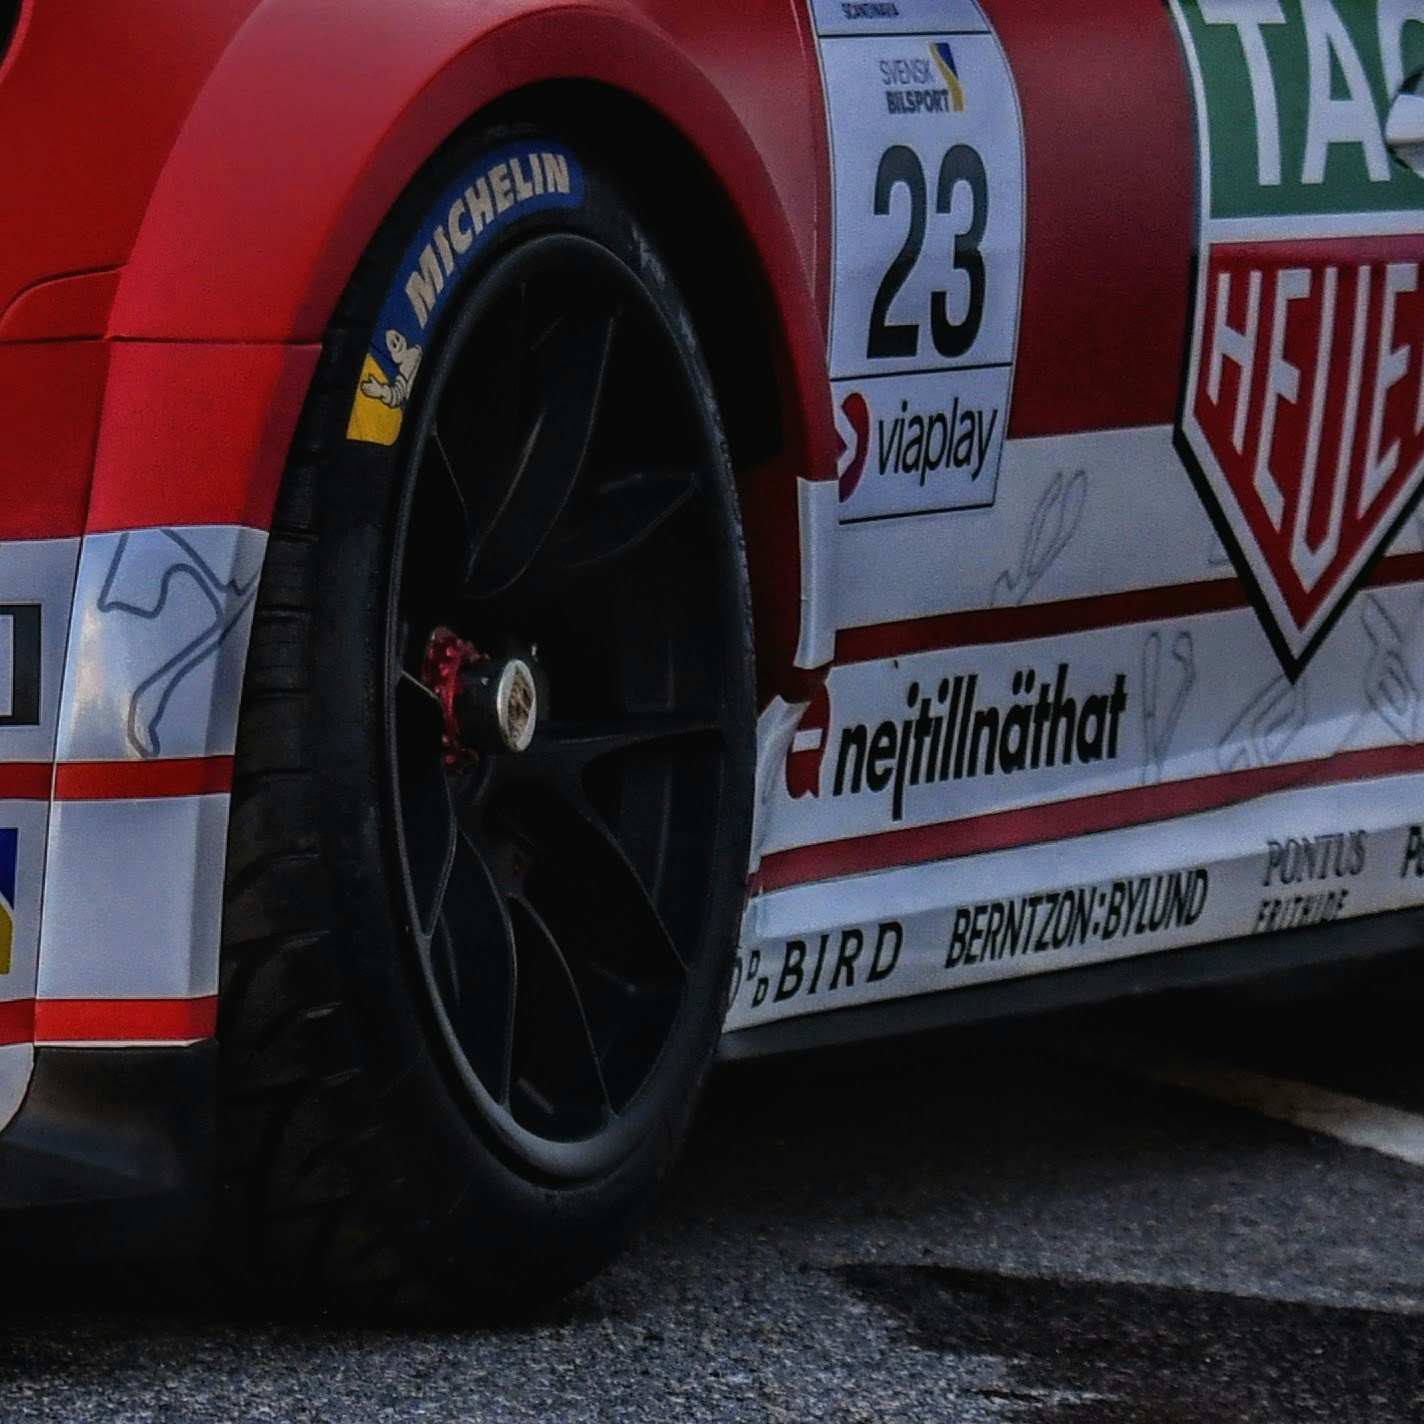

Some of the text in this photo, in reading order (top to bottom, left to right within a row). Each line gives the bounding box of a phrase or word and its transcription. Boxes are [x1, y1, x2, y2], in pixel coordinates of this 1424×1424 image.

[878, 59, 937, 85] SVENSK
[885, 89, 950, 114] BILSPORT
[405, 152, 571, 329] MICHELIN
[867, 144, 988, 360] 23
[877, 396, 998, 488] viaplay
[832, 662, 1127, 822] nejtillnäthat
[1262, 829, 1368, 887] PONTUS
[945, 868, 1209, 969] BERNTZON:BYLUND
